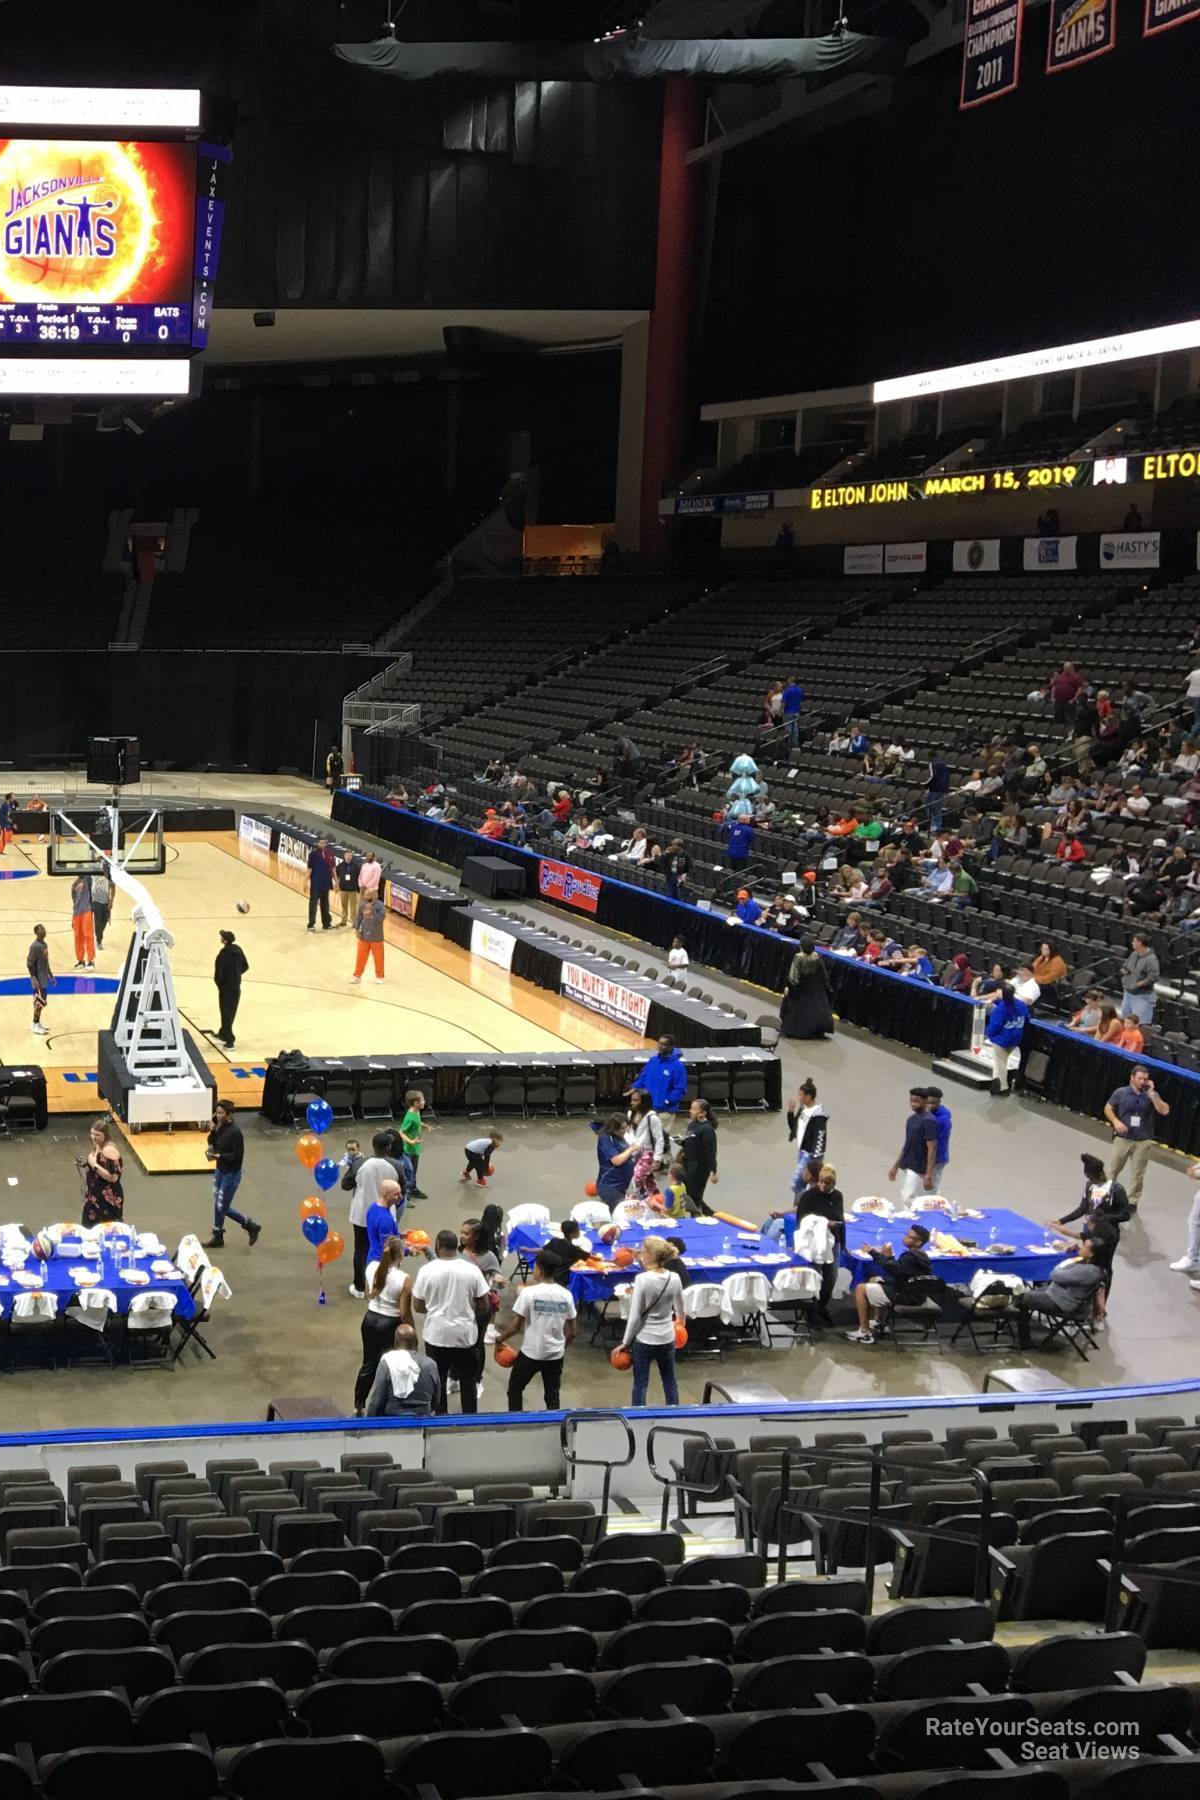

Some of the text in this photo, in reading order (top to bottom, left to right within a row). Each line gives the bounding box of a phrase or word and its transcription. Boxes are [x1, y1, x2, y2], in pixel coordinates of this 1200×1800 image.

[967, 20, 1016, 58] CHAMPIONS
[1055, 13, 1105, 57] GIANTS
[976, 56, 1003, 90] 2011
[5, 205, 115, 256] GIANTS
[37, 303, 58, 311] Fouls
[76, 305, 100, 313] Points
[154, 307, 180, 318] BATS
[36, 313, 75, 324] Period 1
[15, 323, 22, 333] 3
[39, 325, 80, 340] 36:19
[92, 325, 99, 335] 3
[158, 325, 169, 340] 0
[122, 331, 131, 343] 0
[1144, 452, 1200, 480] ELTO
[824, 486, 866, 508] ELTON
[869, 482, 908, 503] JOHN
[925, 475, 985, 496] MARCH
[992, 471, 1021, 491] 15,
[1027, 466, 1078, 487] 2019
[680, 498, 716, 509] MONEY
[1117, 540, 1159, 552] HASTY'S
[567, 965, 647, 1018] YOU HURT? WE FIGHT!
